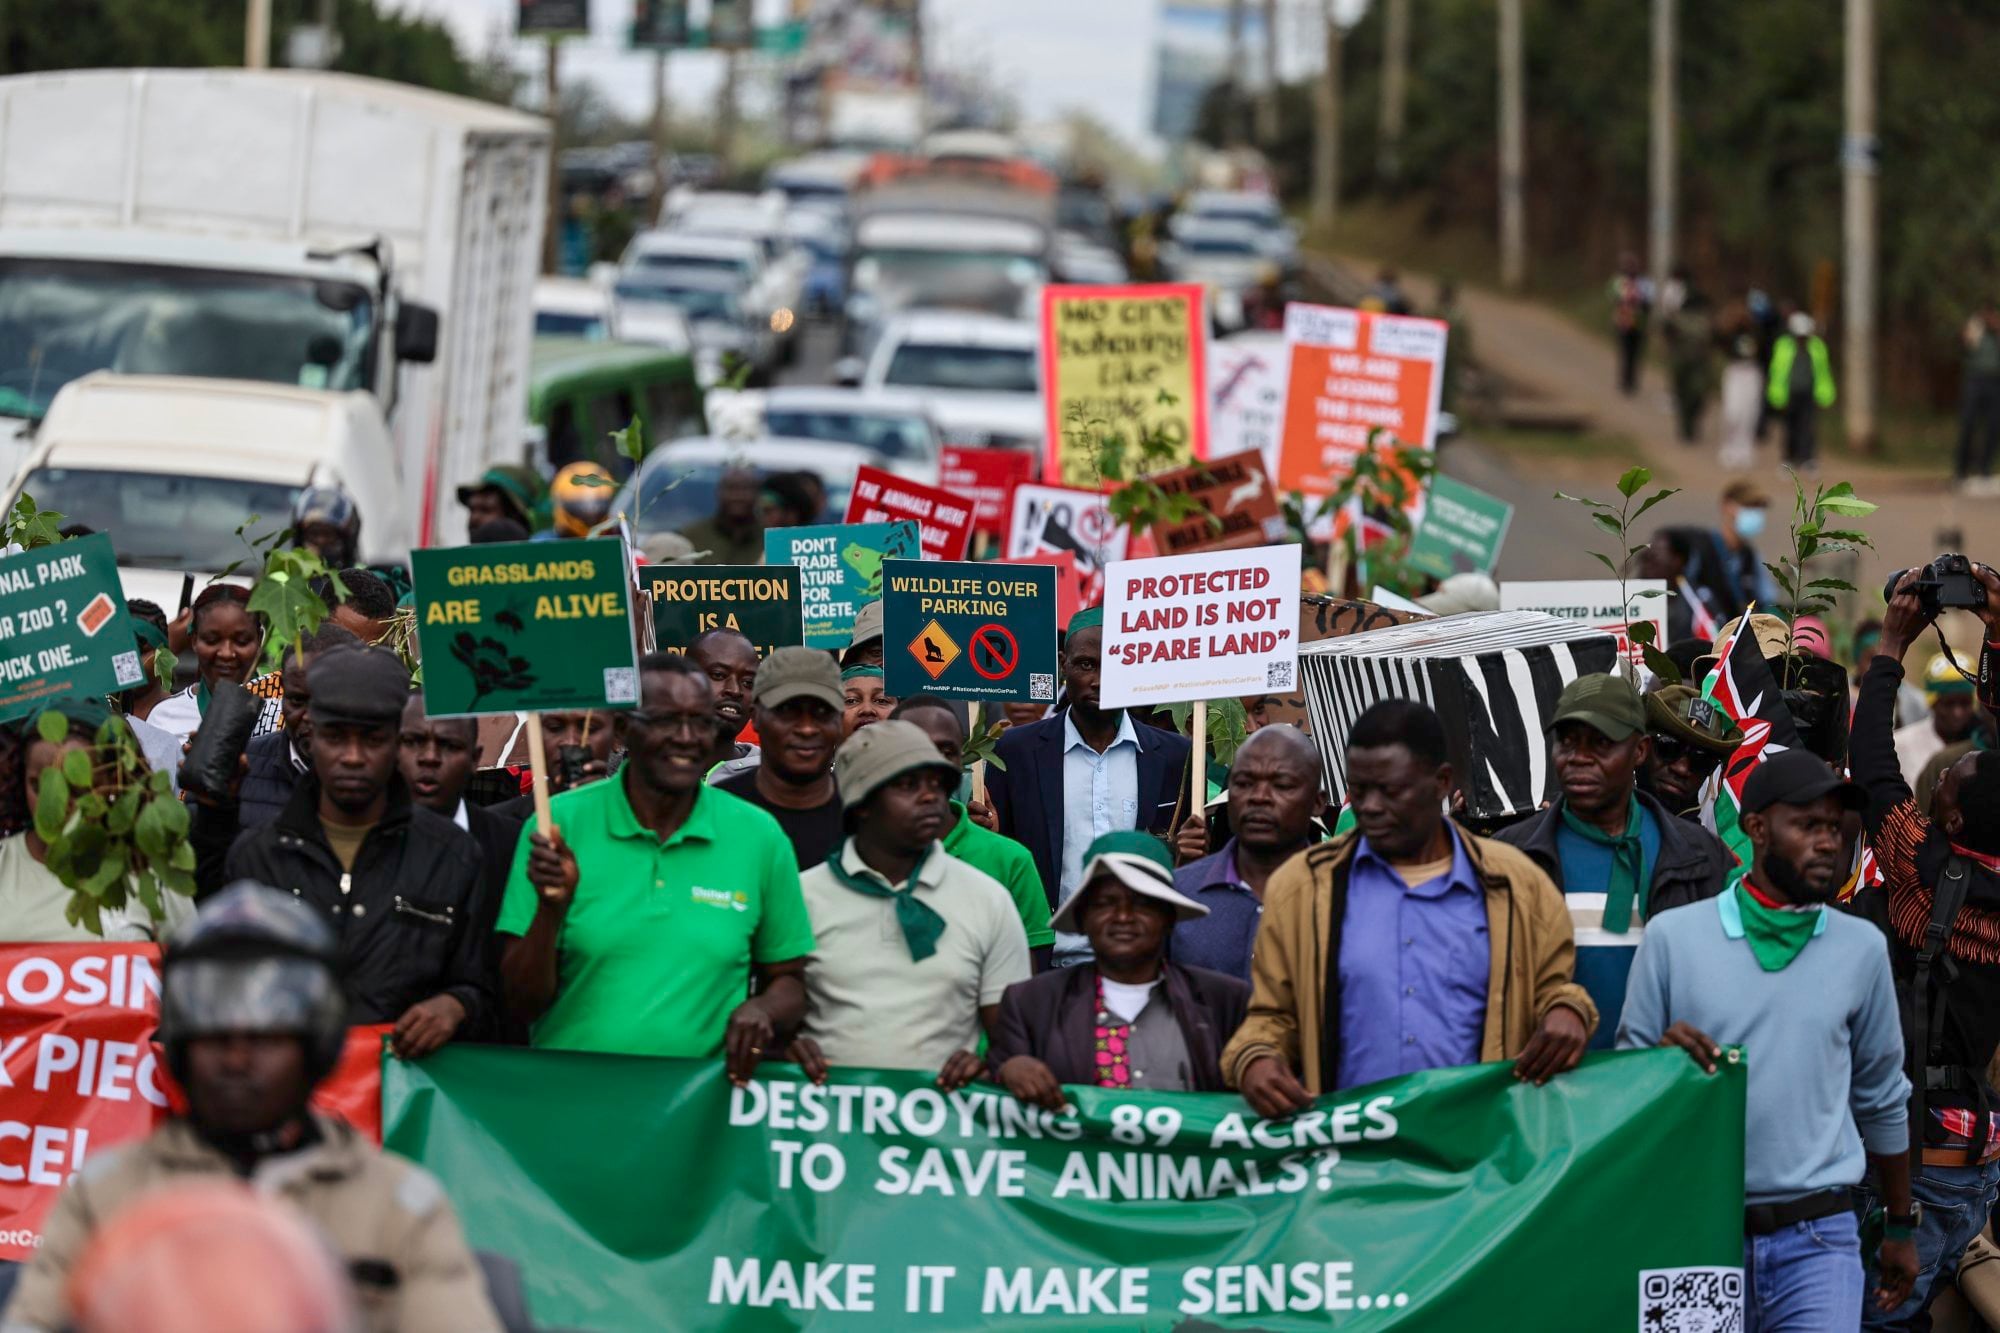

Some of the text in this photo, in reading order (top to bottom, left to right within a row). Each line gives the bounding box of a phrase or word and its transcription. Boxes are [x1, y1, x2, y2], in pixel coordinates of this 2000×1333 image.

[857, 480, 881, 501] THE
[881, 488, 933, 517] ANIMALS
[934, 503, 968, 528] WERE
[791, 537, 837, 554] DON'T
[36, 553, 86, 585] PARK
[448, 560, 595, 586] GRASSLANDS
[791, 554, 838, 569] TRADE
[652, 579, 789, 602] PROTECTION
[801, 569, 844, 586] ATURE
[891, 576, 1038, 597] WILDLIFE OVER
[1126, 567, 1270, 600] PROTECTED
[427, 592, 625, 625] ARE ALIVE.
[802, 587, 831, 602] FOR
[921, 598, 1007, 616] PARKING
[17, 606, 54, 635] ZOO
[699, 612, 741, 633] IS A
[803, 602, 857, 618] NCRETE.
[1121, 598, 1281, 633] LAND IS NOT
[1593, 606, 1624, 617] LAND
[1629, 606, 1640, 617] IS
[37, 644, 89, 673] ONE...
[1108, 629, 1290, 665] “SPARE LAND”
[0, 955, 163, 1010] OSIN
[33, 1033, 168, 1107] PIEC
[729, 1078, 1399, 1149] DESTROYING 89 ACRES
[770, 1140, 1341, 1200] TO SAVE ANIMALS?
[708, 1256, 1409, 1314] MAKE IT MAKE SENSE...
